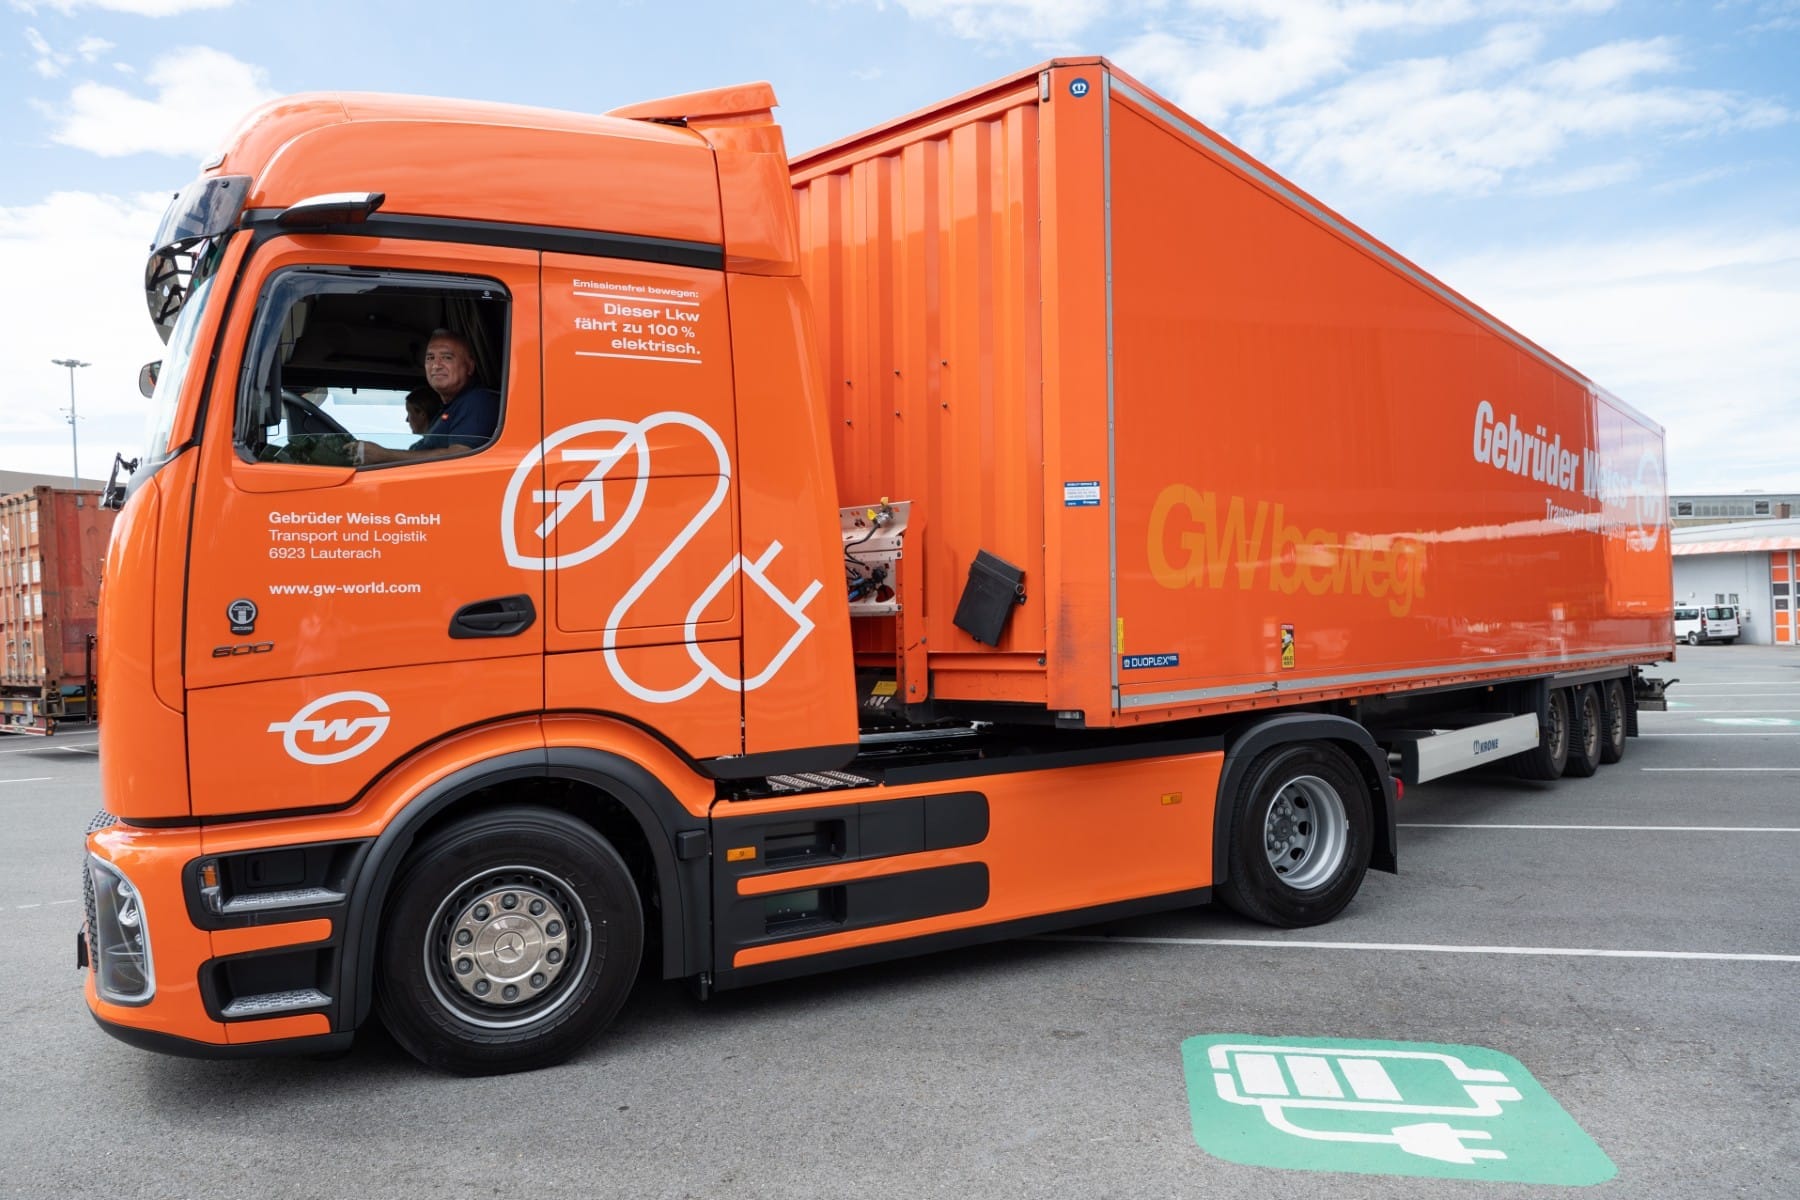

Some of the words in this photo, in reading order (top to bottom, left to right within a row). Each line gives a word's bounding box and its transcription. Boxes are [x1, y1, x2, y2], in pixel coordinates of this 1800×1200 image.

[572, 279, 645, 293] Emissionsfrei
[648, 286, 699, 298] bewegen:
[604, 303, 660, 318] Dieser
[665, 308, 700, 322] Lkw
[574, 317, 617, 332] fährt
[623, 324, 642, 334] zu
[648, 324, 678, 337] 100
[681, 326, 696, 338] %
[611, 337, 701, 355] elektrisch.
[1473, 400, 1580, 493] Gebrüder
[1583, 447, 1628, 510] Weiss
[268, 511, 343, 525] Gebrüder
[346, 512, 391, 525] Weiss
[394, 513, 441, 526] GmbH
[1546, 498, 1585, 531] Transport
[268, 529, 338, 544] Transport
[342, 530, 369, 542] und
[374, 530, 427, 544] Logistik
[268, 547, 306, 559] 6923
[310, 547, 382, 560] Lauterach
[268, 581, 422, 597] www.gw-world.com
[212, 641, 275, 658] 600
[1131, 656, 1169, 668] DUOPLEX
[1480, 738, 1499, 753] KRONE
